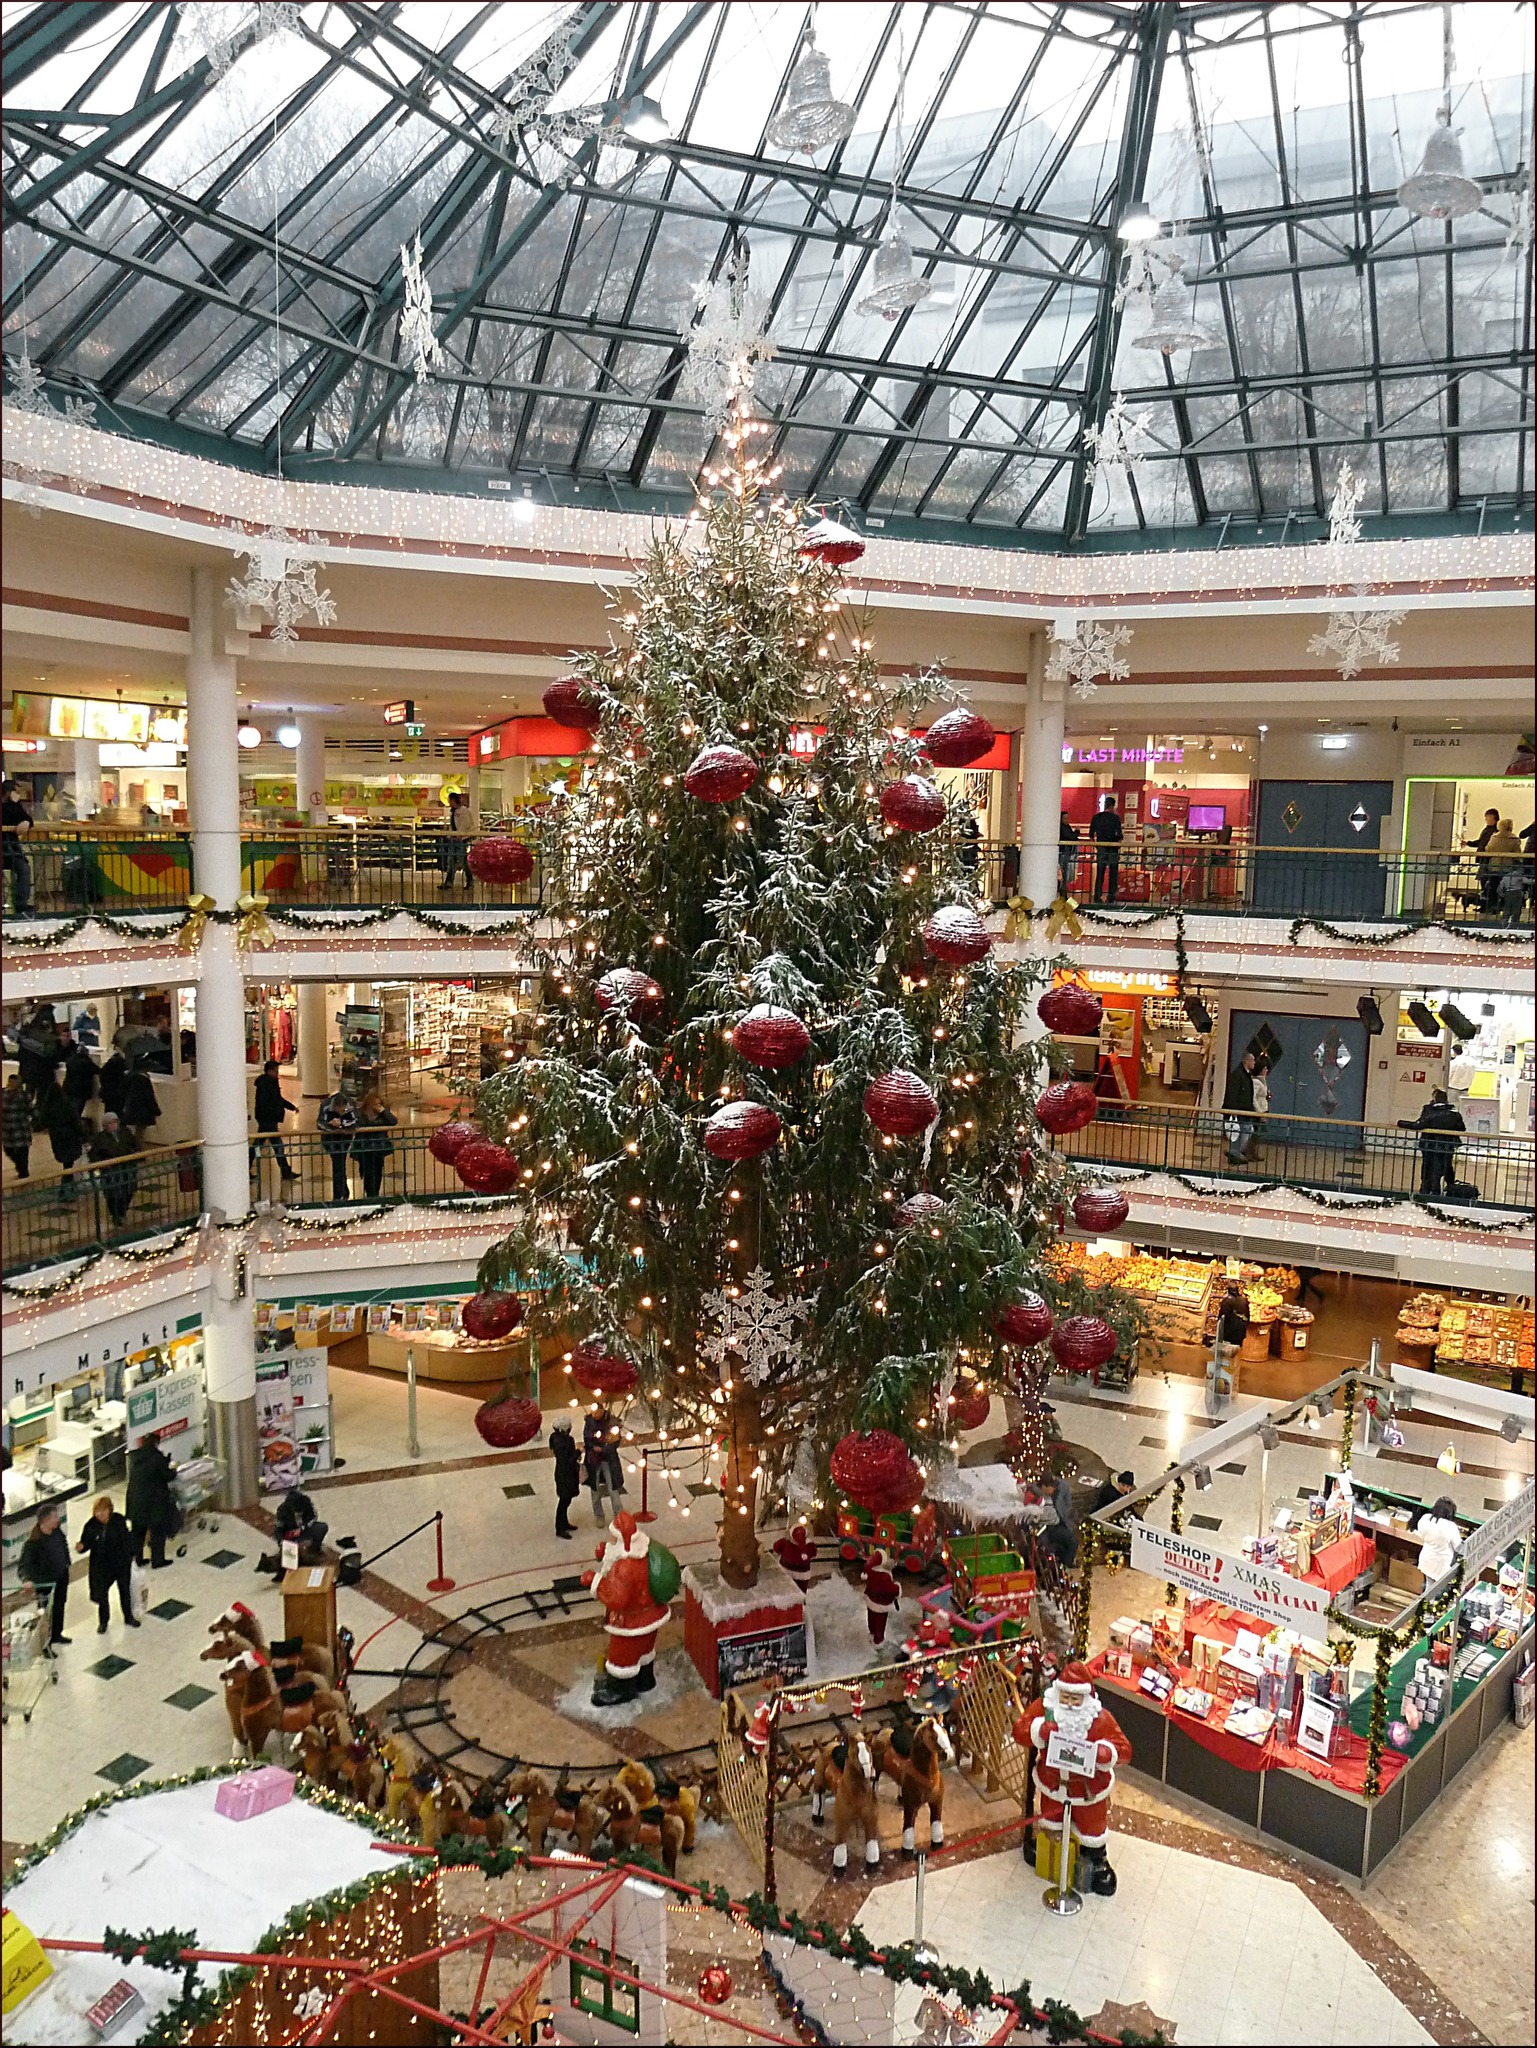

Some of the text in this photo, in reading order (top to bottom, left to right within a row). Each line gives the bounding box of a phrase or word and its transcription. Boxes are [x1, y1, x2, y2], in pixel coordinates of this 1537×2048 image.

[1412, 738, 1461, 747] Einfach A1
[1078, 748, 1184, 763] LAST MINUTE
[1501, 781, 1526, 789] Einfach
[78, 1325, 168, 1372] Markt
[158, 1374, 202, 1399] Express-
[159, 1393, 195, 1417] Kassen
[1137, 1526, 1211, 1563] TELESHOP
[1164, 1551, 1211, 1575] OUTLET
[1233, 1565, 1282, 1594] XMAS
[1163, 1567, 1180, 1578] noch
[1181, 1574, 1199, 1586] mehr
[1200, 1581, 1230, 1598] Auswahl
[1231, 1593, 1239, 1602] in
[1239, 1597, 1271, 1613] unserem
[1273, 1609, 1293, 1623] Shop
[1178, 1580, 1265, 1618] OBERGESCHOSS TOP 15
[1253, 1588, 1319, 1613] SPECIAL
